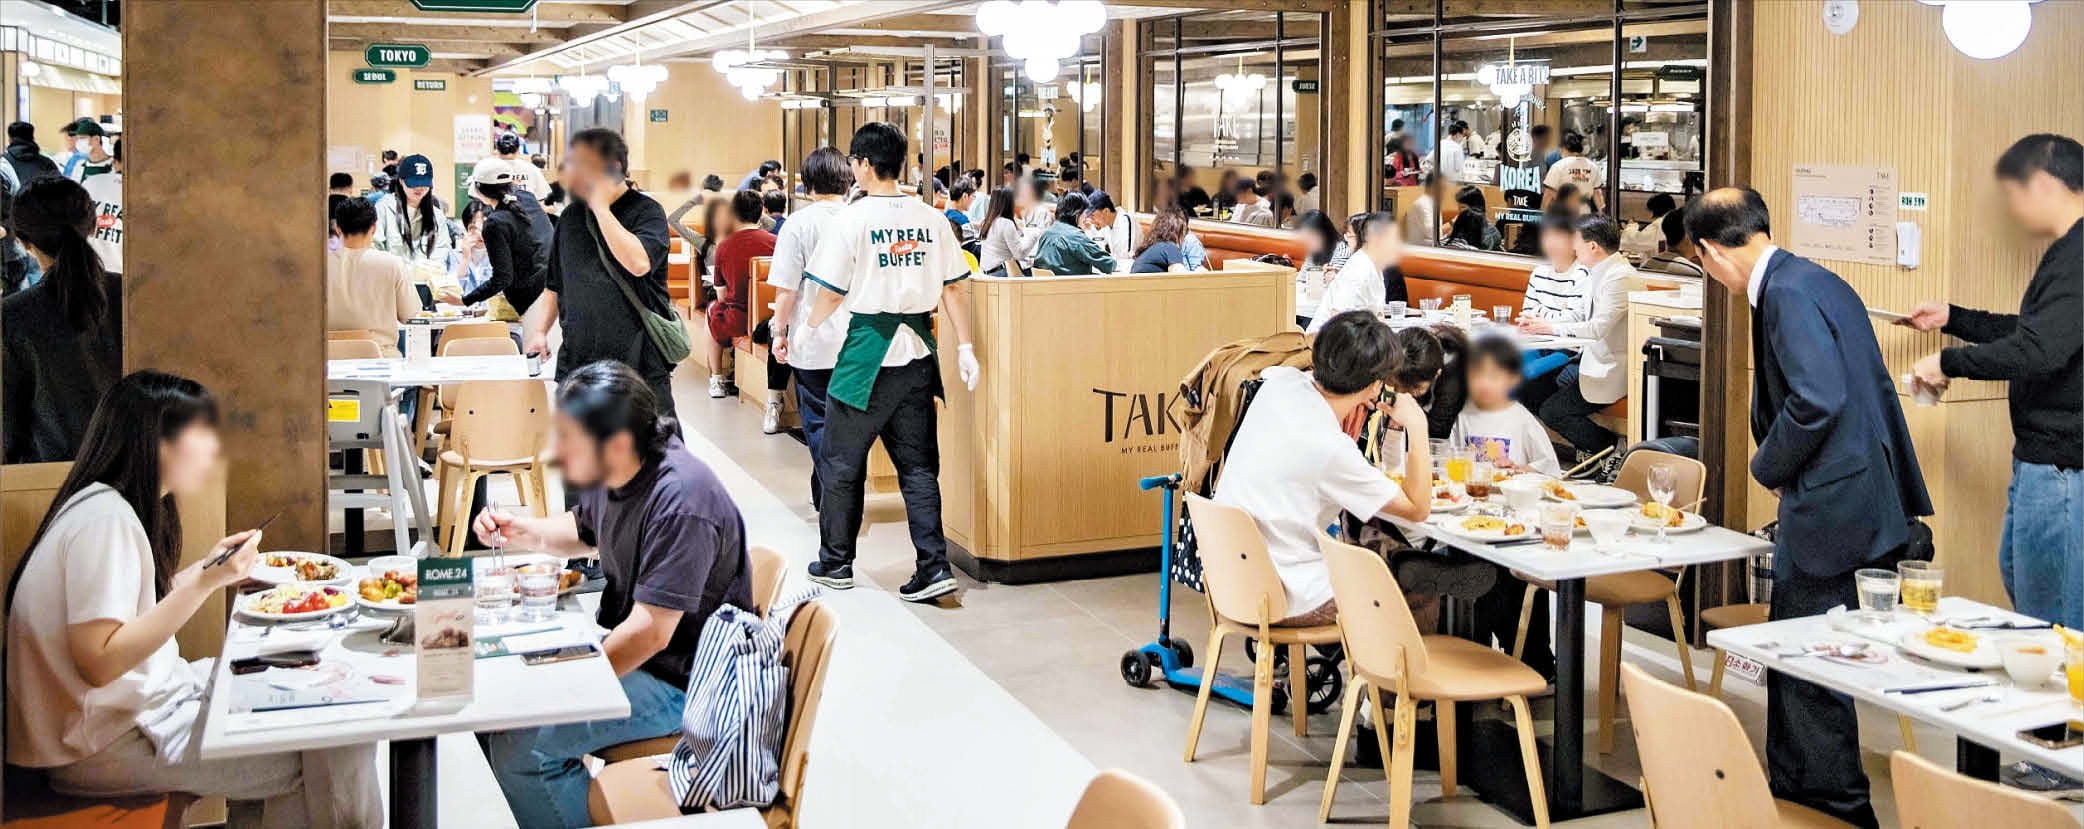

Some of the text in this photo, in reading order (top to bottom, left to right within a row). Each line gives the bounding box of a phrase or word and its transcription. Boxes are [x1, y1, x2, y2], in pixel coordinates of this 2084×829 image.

[379, 49, 417, 62] TOKYO
[1500, 164, 1541, 194] KOREA
[103, 203, 122, 219] RE
[871, 228, 933, 244] MY REAL
[878, 251, 926, 268] BUFFET
[1092, 387, 1182, 443] TAK
[1121, 443, 1179, 455] MY REAL BUFF
